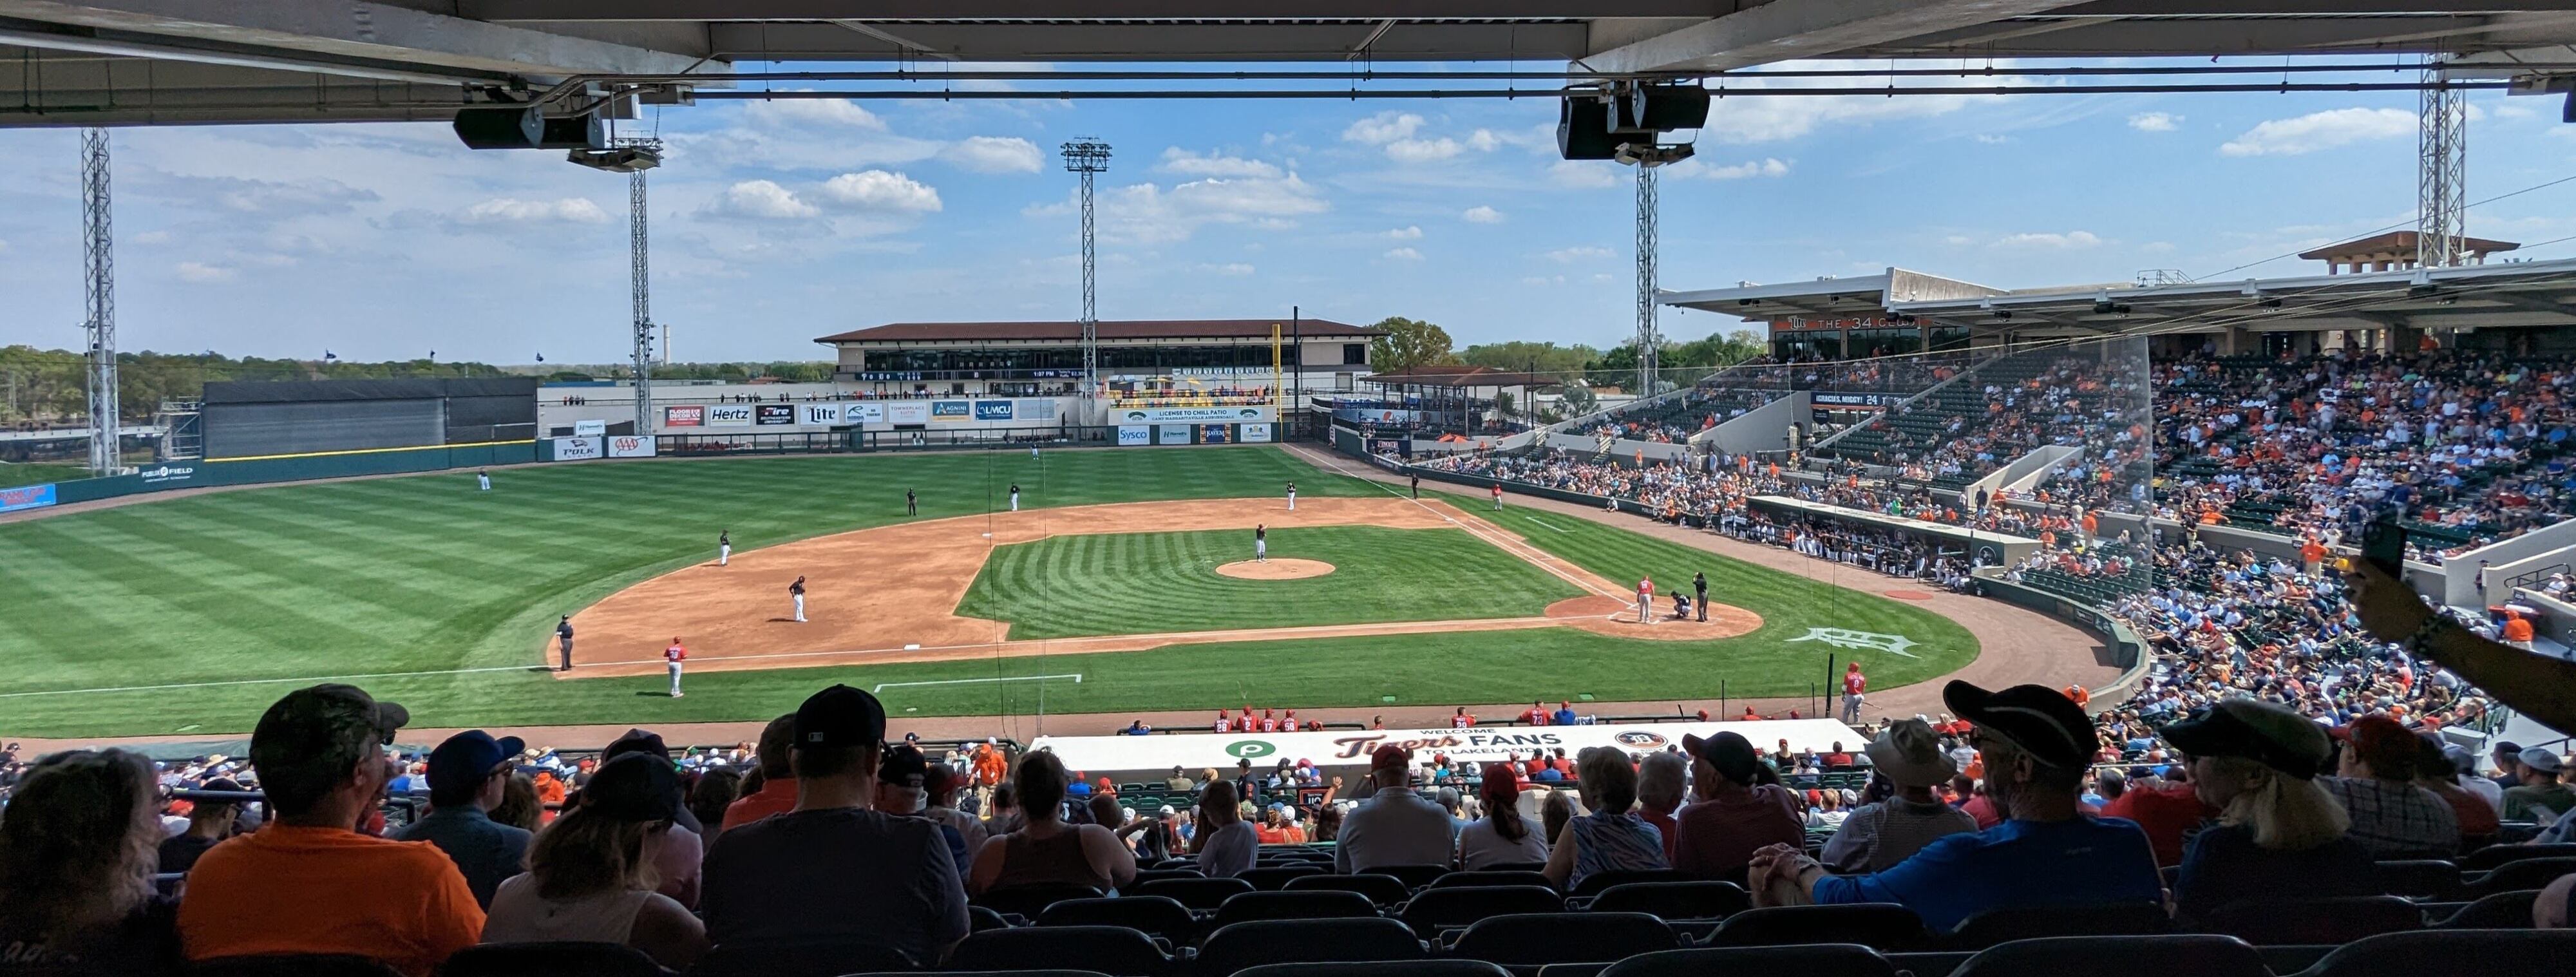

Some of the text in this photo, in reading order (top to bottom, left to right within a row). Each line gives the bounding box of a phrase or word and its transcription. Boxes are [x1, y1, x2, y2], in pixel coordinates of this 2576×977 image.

[1818, 320, 1841, 328] THE
[1866, 395, 1878, 404] 24
[712, 409, 750, 420] Hertz
[811, 408, 836, 423] Lite
[1120, 430, 1147, 441] Sysco
[618, 438, 636, 450] AAA
[1245, 721, 1250, 730] 2
[1533, 716, 1542, 725] 73
[1264, 723, 1273, 732] 17
[1468, 734, 1562, 746] FANS
